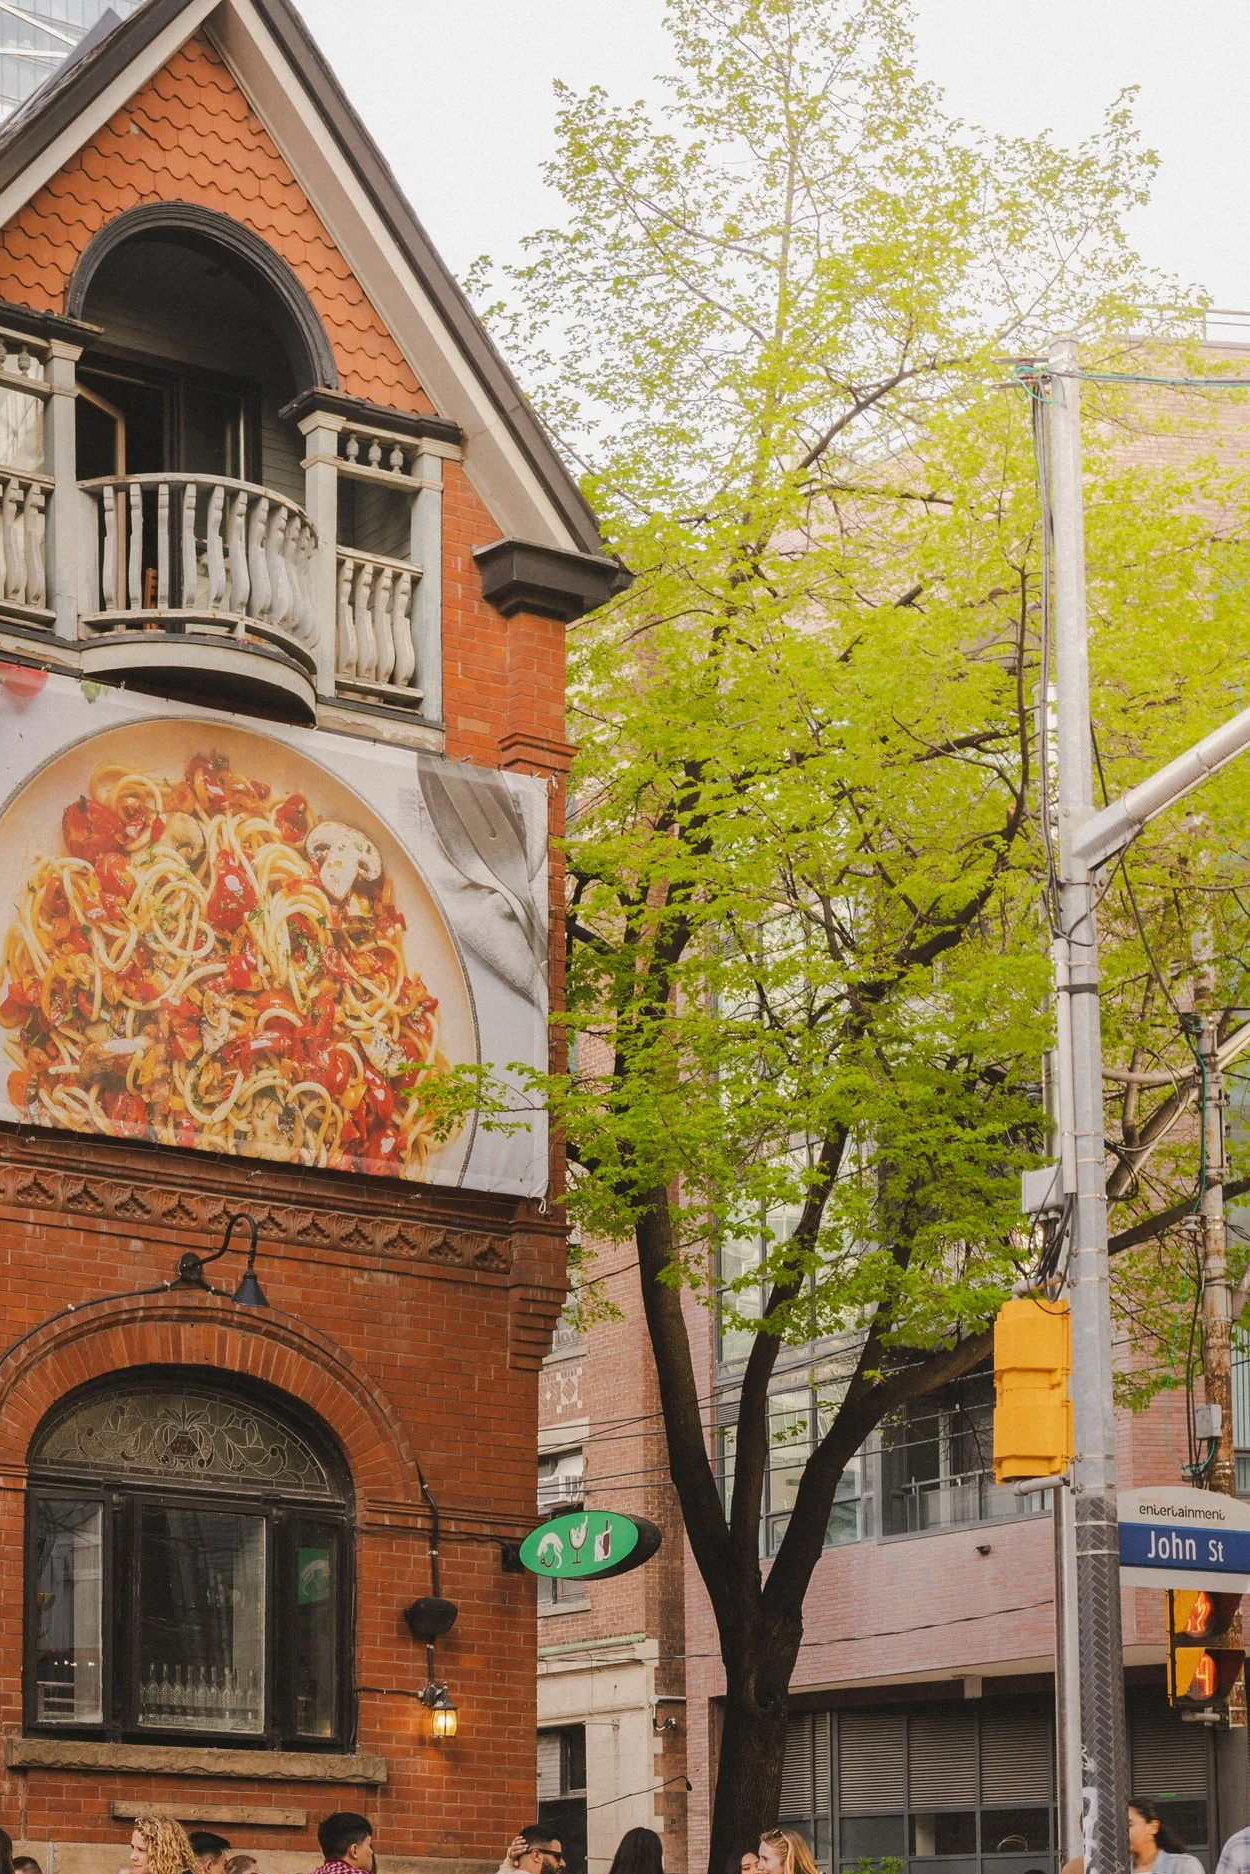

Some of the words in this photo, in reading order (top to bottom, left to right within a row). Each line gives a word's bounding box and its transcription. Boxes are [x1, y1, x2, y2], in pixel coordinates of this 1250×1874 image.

[1139, 1504, 1226, 1521] entertainment
[1147, 1530, 1197, 1561] John
[1208, 1539, 1224, 1562] St
